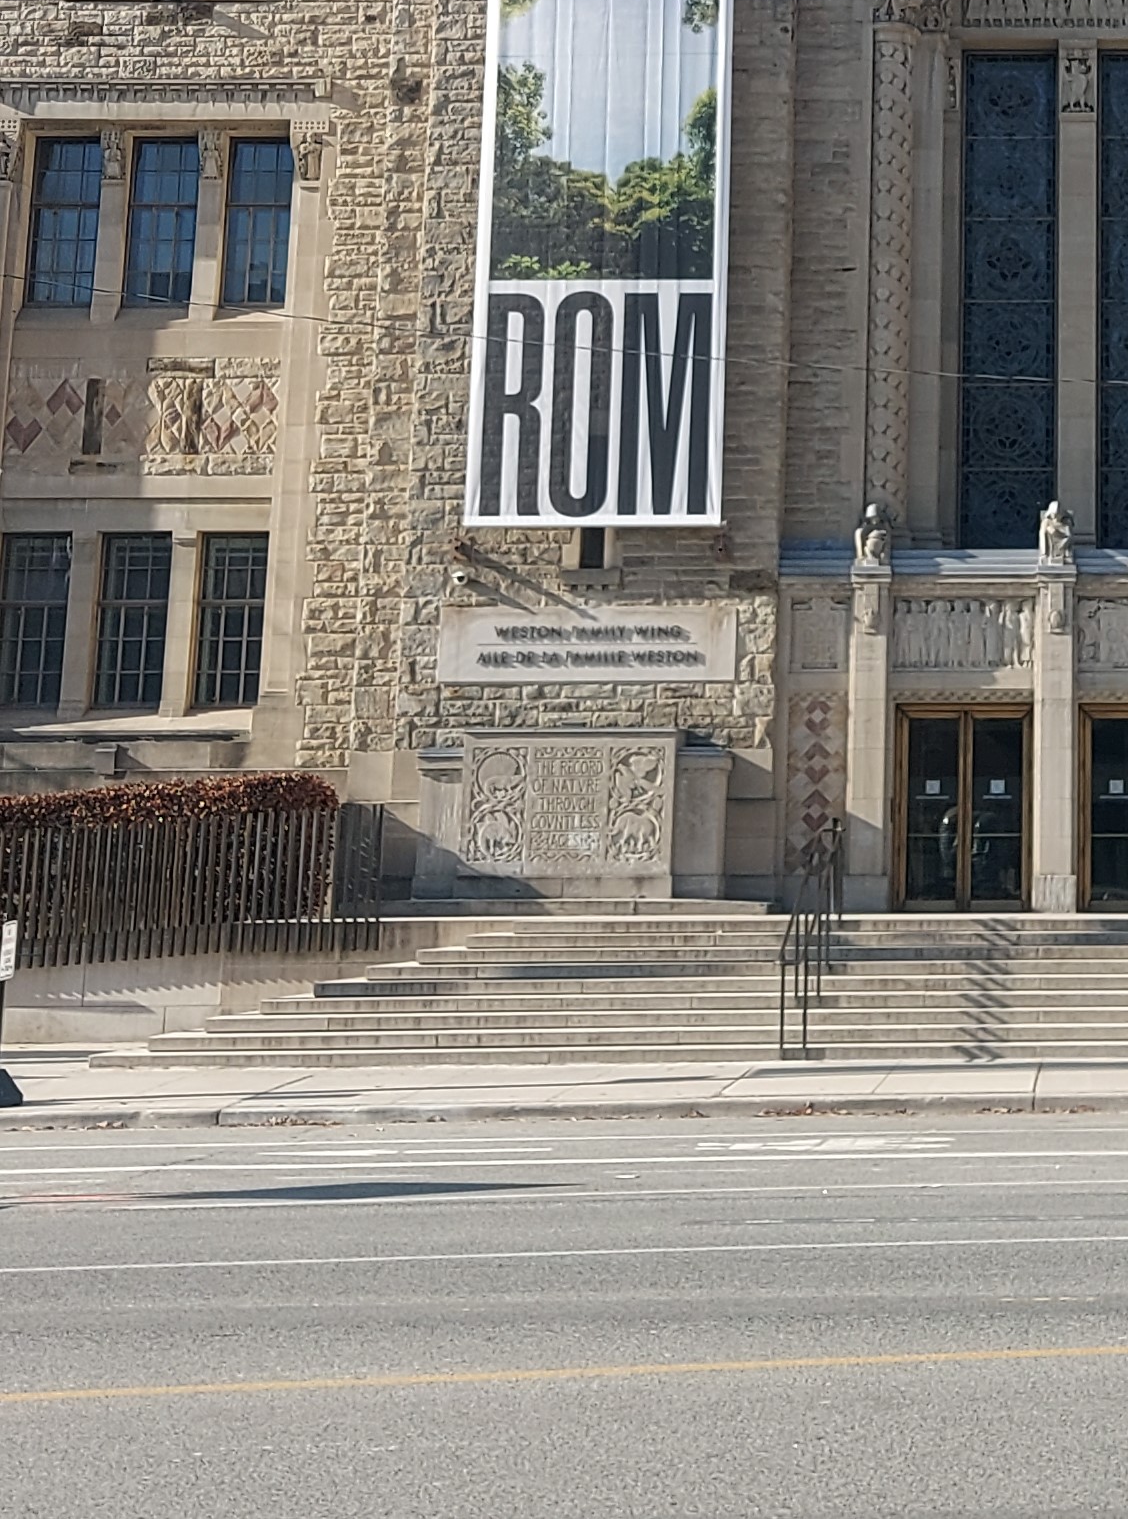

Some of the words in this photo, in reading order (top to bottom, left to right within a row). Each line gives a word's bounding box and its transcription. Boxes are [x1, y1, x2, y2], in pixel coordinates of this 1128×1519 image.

[478, 291, 713, 517] ROM
[494, 625, 562, 639] WESTON
[634, 624, 683, 638] WING
[631, 649, 698, 663] WESTON
[537, 760, 559, 776] THE
[561, 760, 604, 776] RECORD
